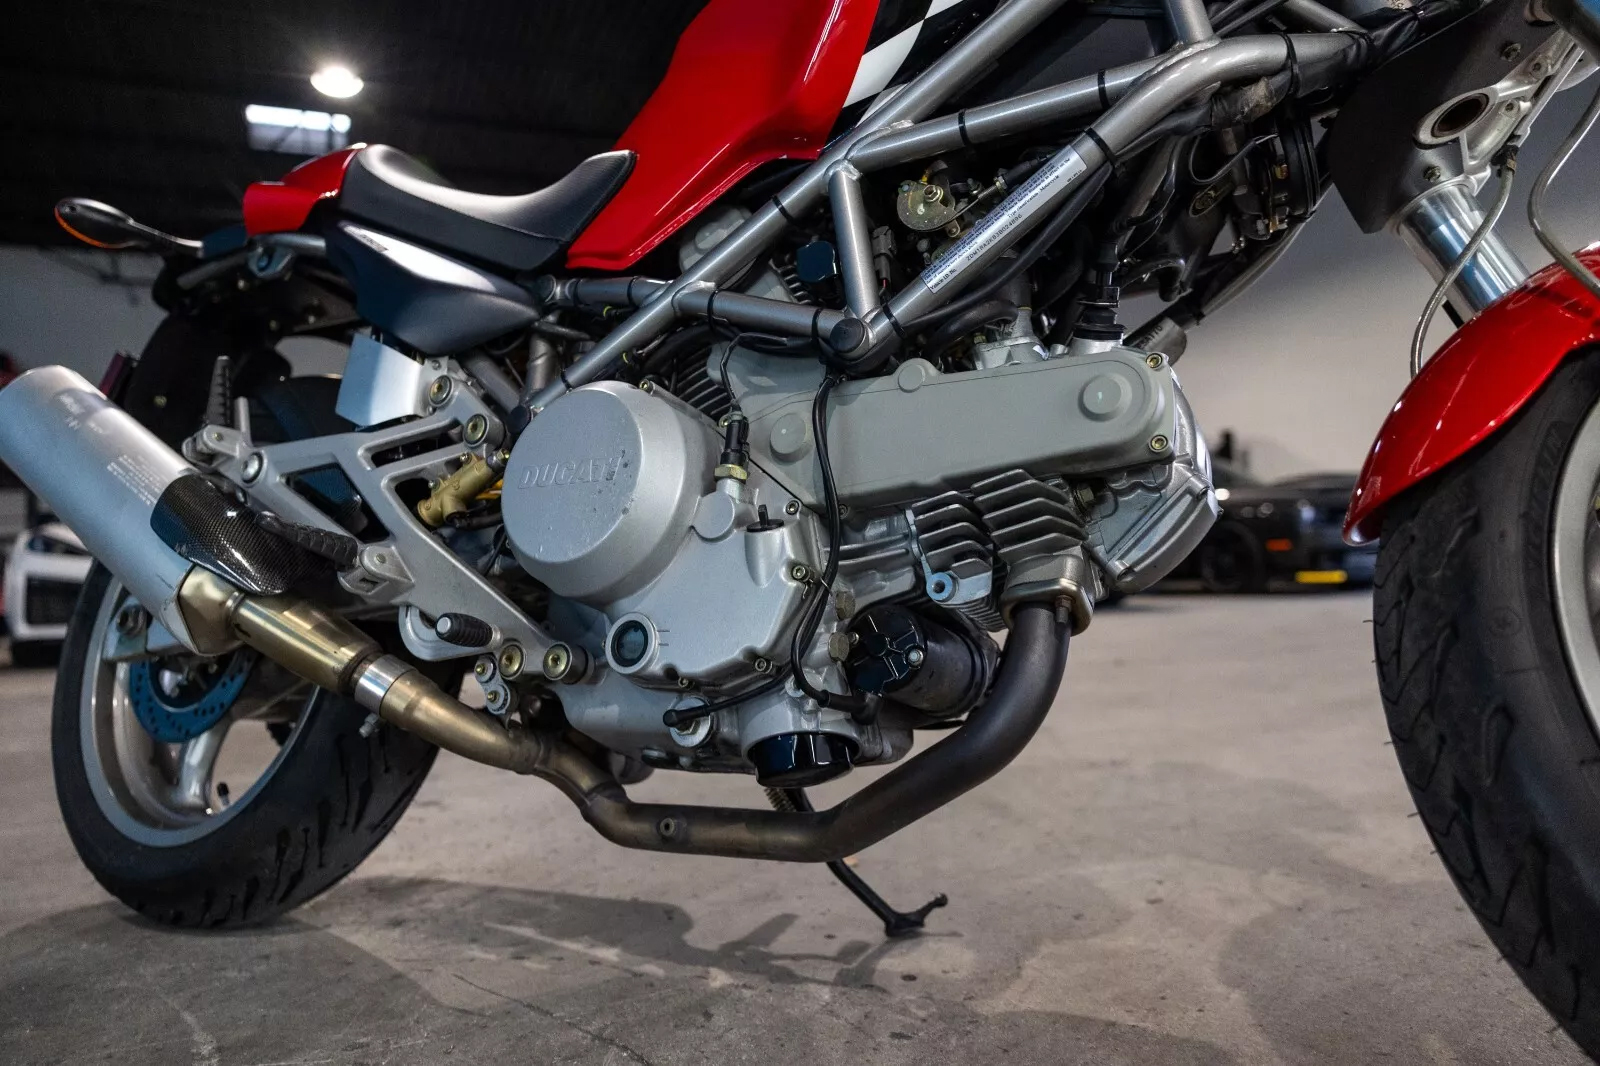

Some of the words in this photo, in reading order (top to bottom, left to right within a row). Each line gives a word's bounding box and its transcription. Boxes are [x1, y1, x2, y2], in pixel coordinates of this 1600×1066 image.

[1007, 209, 1016, 218] Type
[1039, 174, 1059, 191] Motorcycle
[929, 277, 943, 290] Vehicle
[518, 456, 622, 489] DUCATI
